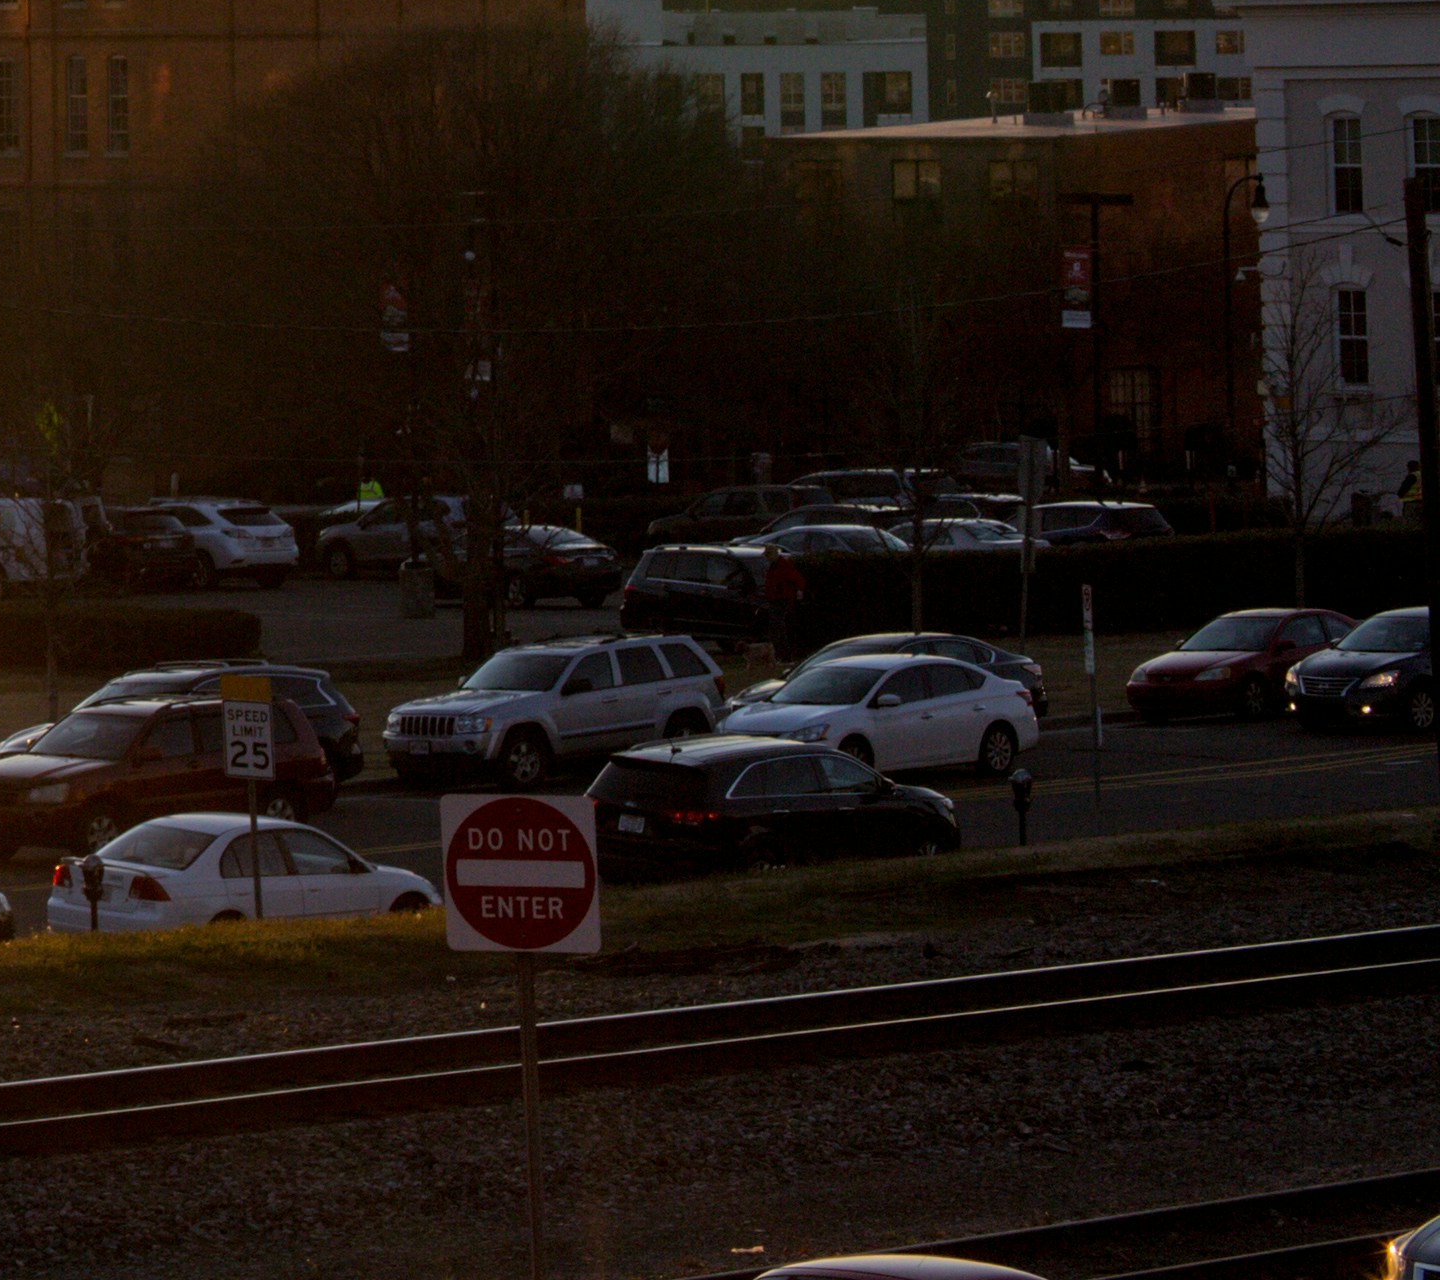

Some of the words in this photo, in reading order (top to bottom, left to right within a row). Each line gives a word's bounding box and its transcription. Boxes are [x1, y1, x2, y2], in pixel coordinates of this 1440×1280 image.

[226, 708, 268, 723] SPEED
[232, 724, 264, 737] LIMIT
[230, 740, 270, 770] 25
[467, 827, 504, 851] DO
[517, 828, 571, 852] NOT
[481, 895, 564, 920] ENTER
